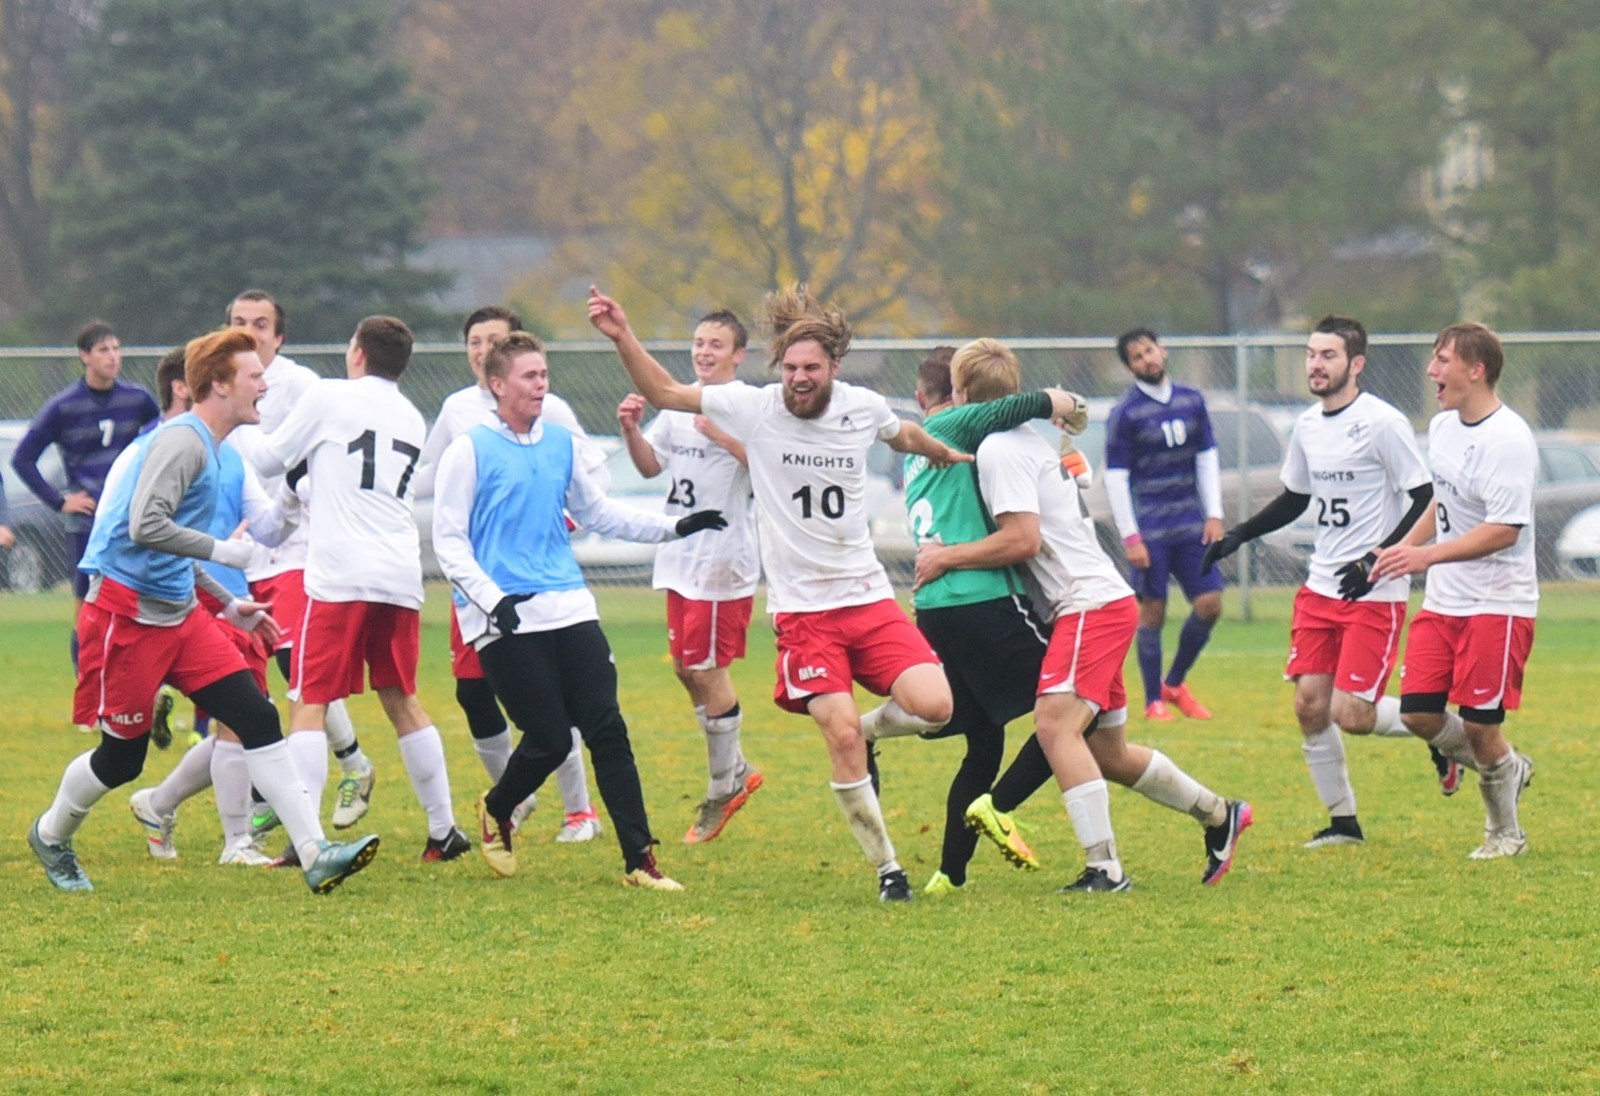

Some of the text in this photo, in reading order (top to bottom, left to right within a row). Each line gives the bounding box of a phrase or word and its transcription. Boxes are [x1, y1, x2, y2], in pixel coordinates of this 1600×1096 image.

[97, 418, 115, 447] 7
[347, 428, 421, 500] 17
[782, 452, 855, 470] KNIGHTS
[791, 484, 846, 520] 10
[1317, 496, 1351, 528] 25
[1436, 501, 1451, 534] 9
[110, 712, 144, 726] MLC
